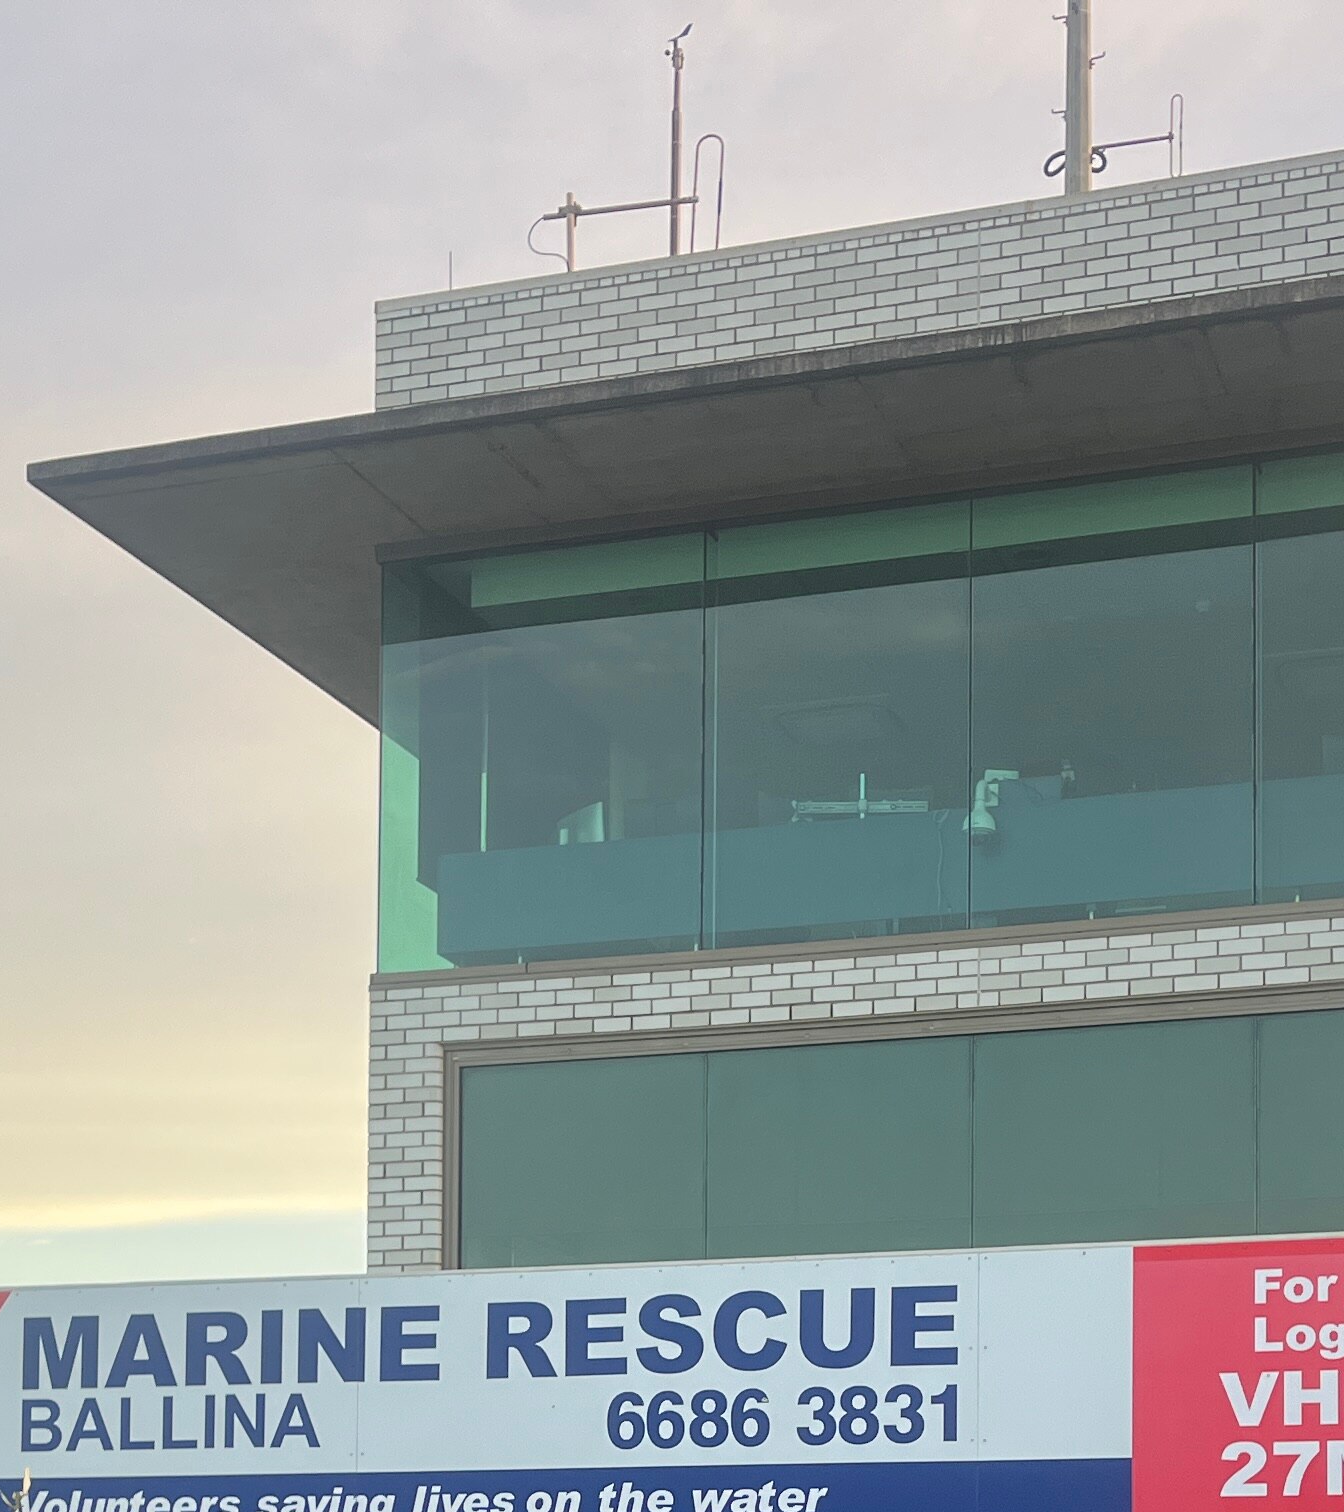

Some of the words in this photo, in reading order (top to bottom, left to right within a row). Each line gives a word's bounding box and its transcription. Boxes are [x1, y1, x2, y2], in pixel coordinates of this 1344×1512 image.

[1253, 1267, 1339, 1305] For
[21, 1305, 441, 1390] MARINE
[485, 1284, 959, 1380] RESCUE
[20, 1392, 321, 1452] BALLINA
[606, 1388, 771, 1450] 6686
[795, 1383, 958, 1445] 3831
